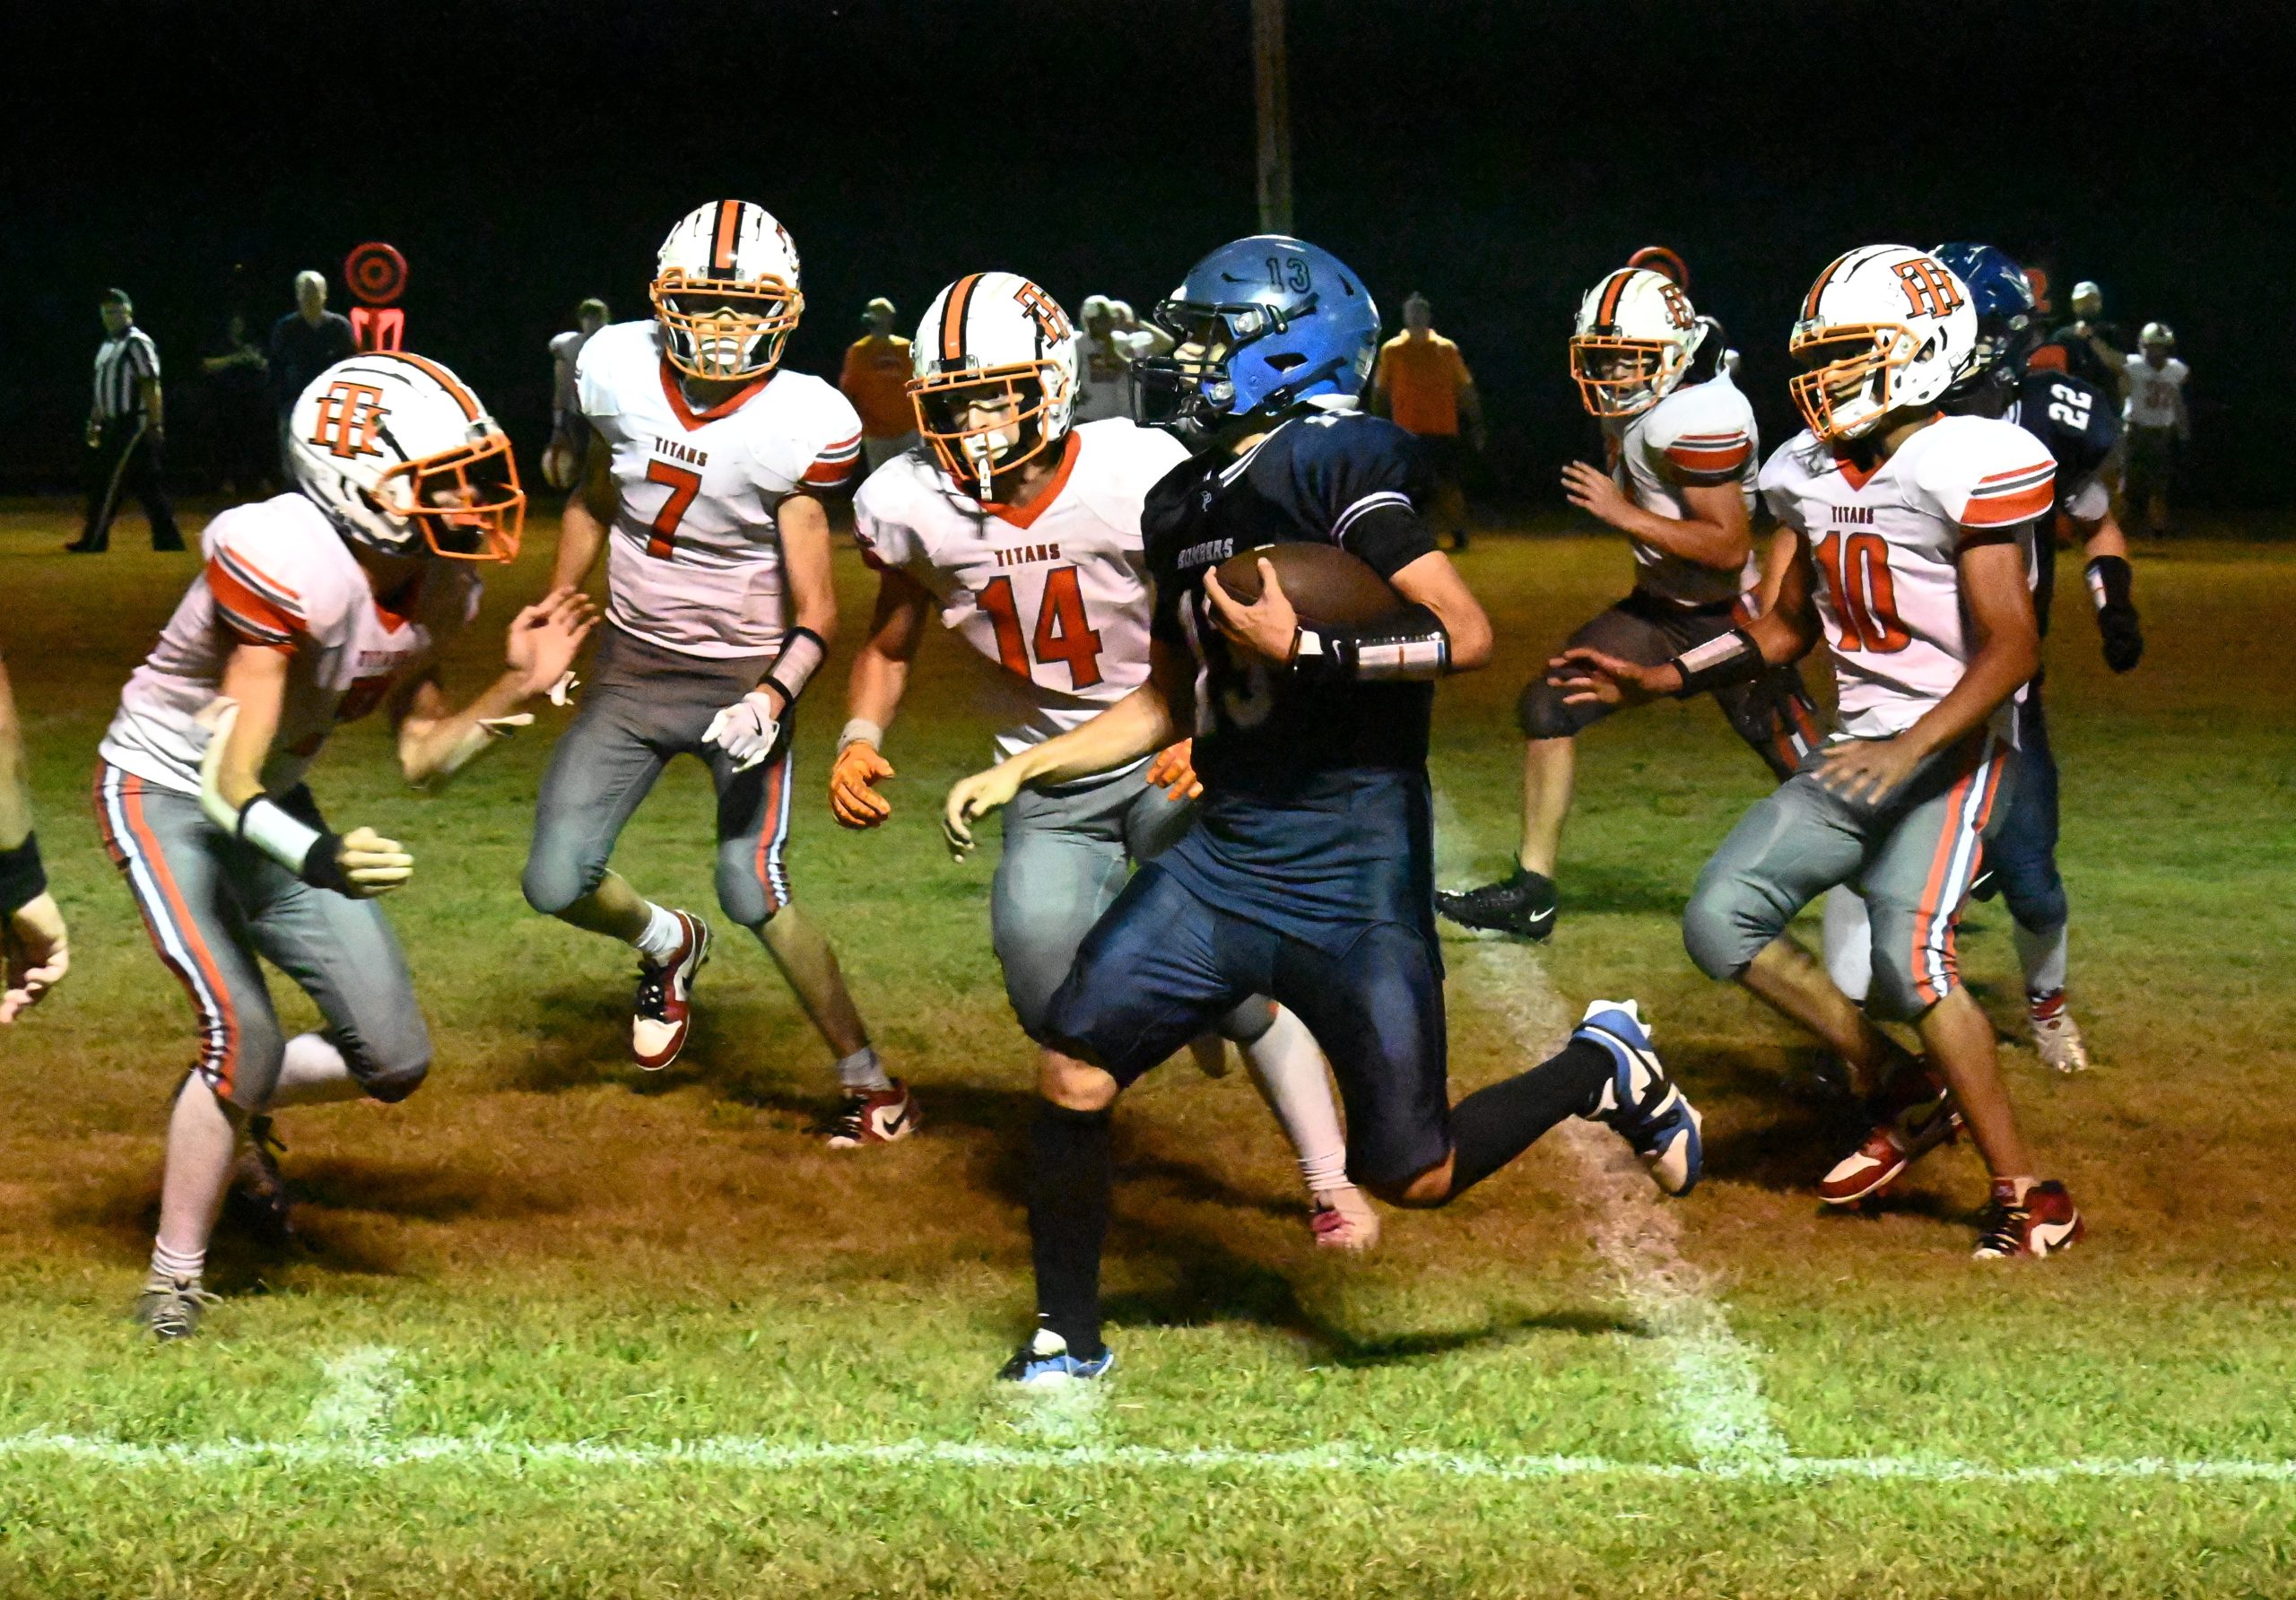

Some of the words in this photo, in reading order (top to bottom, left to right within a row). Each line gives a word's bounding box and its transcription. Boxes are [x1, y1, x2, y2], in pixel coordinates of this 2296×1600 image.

[1265, 257, 1311, 293] 13
[2048, 383, 2092, 430] 22
[655, 436, 709, 467] TITANS
[645, 457, 703, 560] 7
[1831, 506, 1874, 524] TITANS
[995, 543, 1060, 567] TITANS
[1178, 537, 1234, 570] BOMBERS
[1815, 530, 1911, 654] 10
[974, 565, 1104, 691] 14
